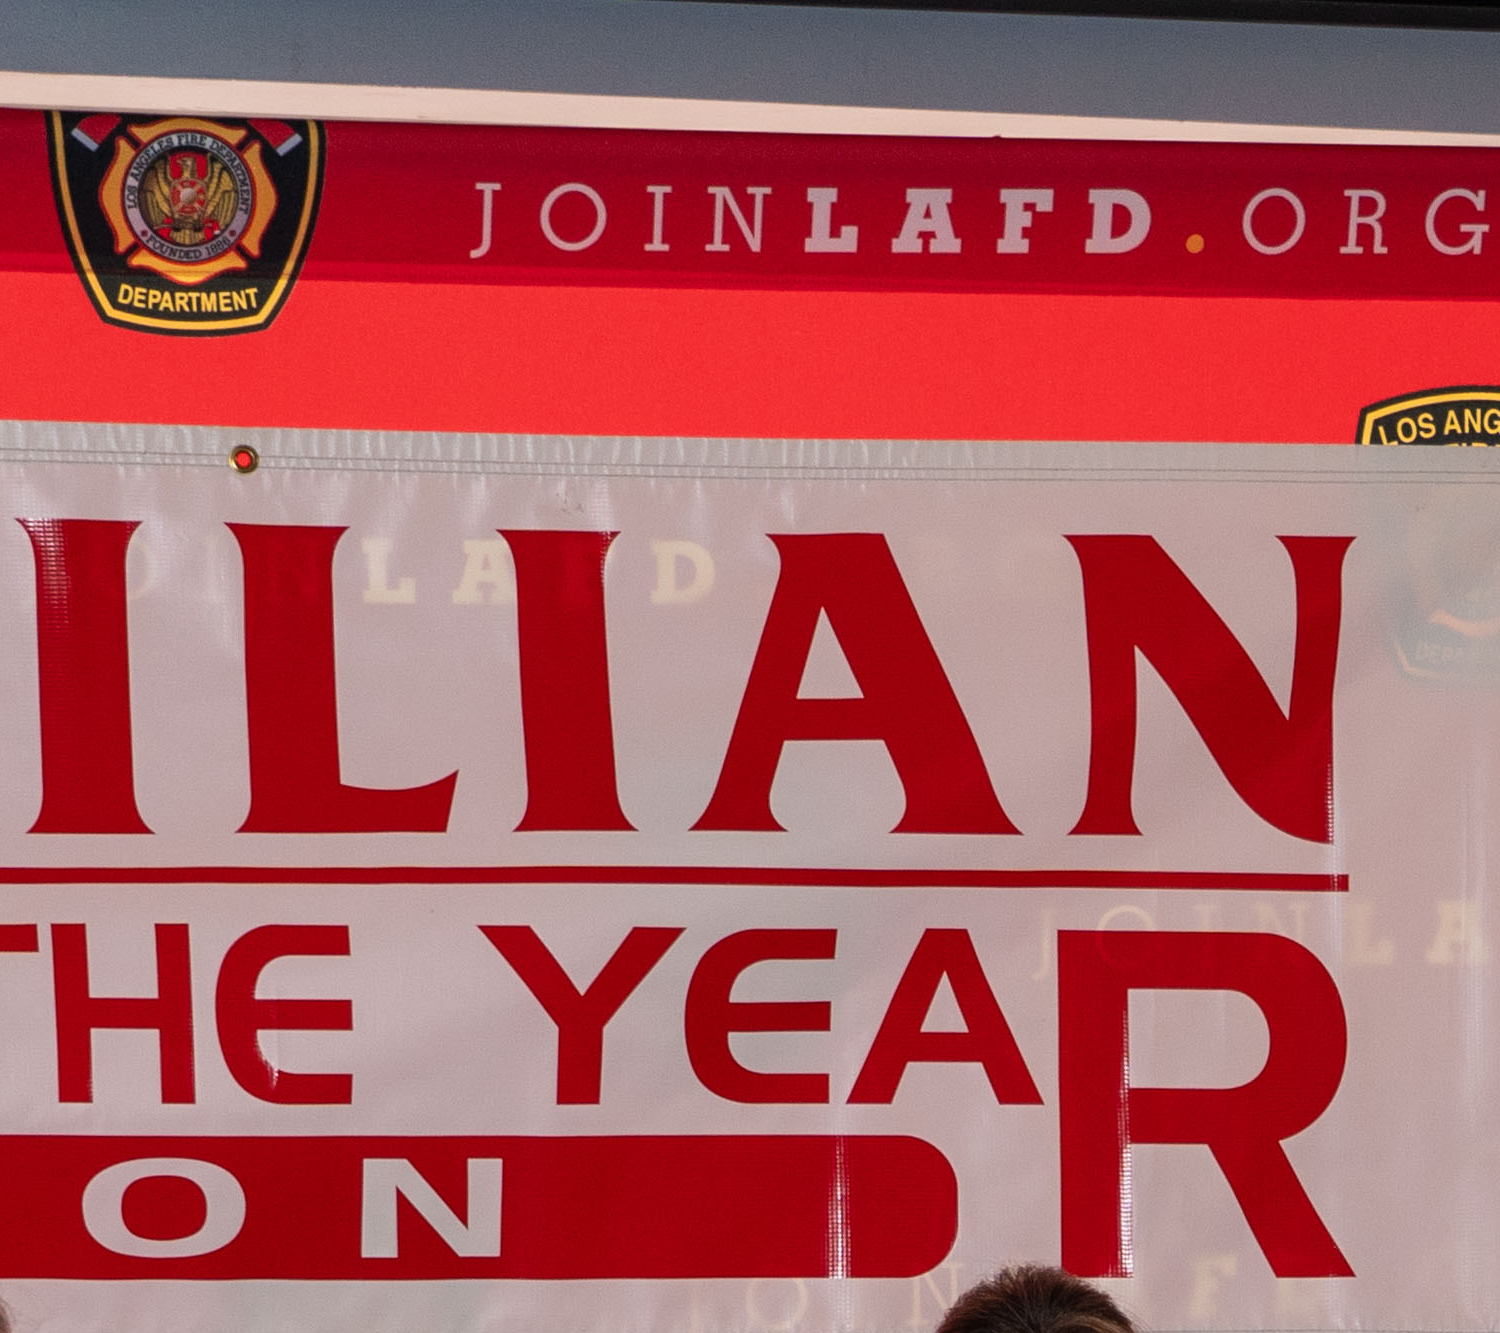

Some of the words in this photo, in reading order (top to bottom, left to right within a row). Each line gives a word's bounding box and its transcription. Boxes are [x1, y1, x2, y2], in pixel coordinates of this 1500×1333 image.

[177, 133, 207, 147] FIRE
[470, 180, 1489, 260] JOINLAFD.ORG
[118, 283, 258, 313] DEPARTMENT
[1378, 412, 1436, 446] LOS
[479, 922, 1352, 1279] YEAR
